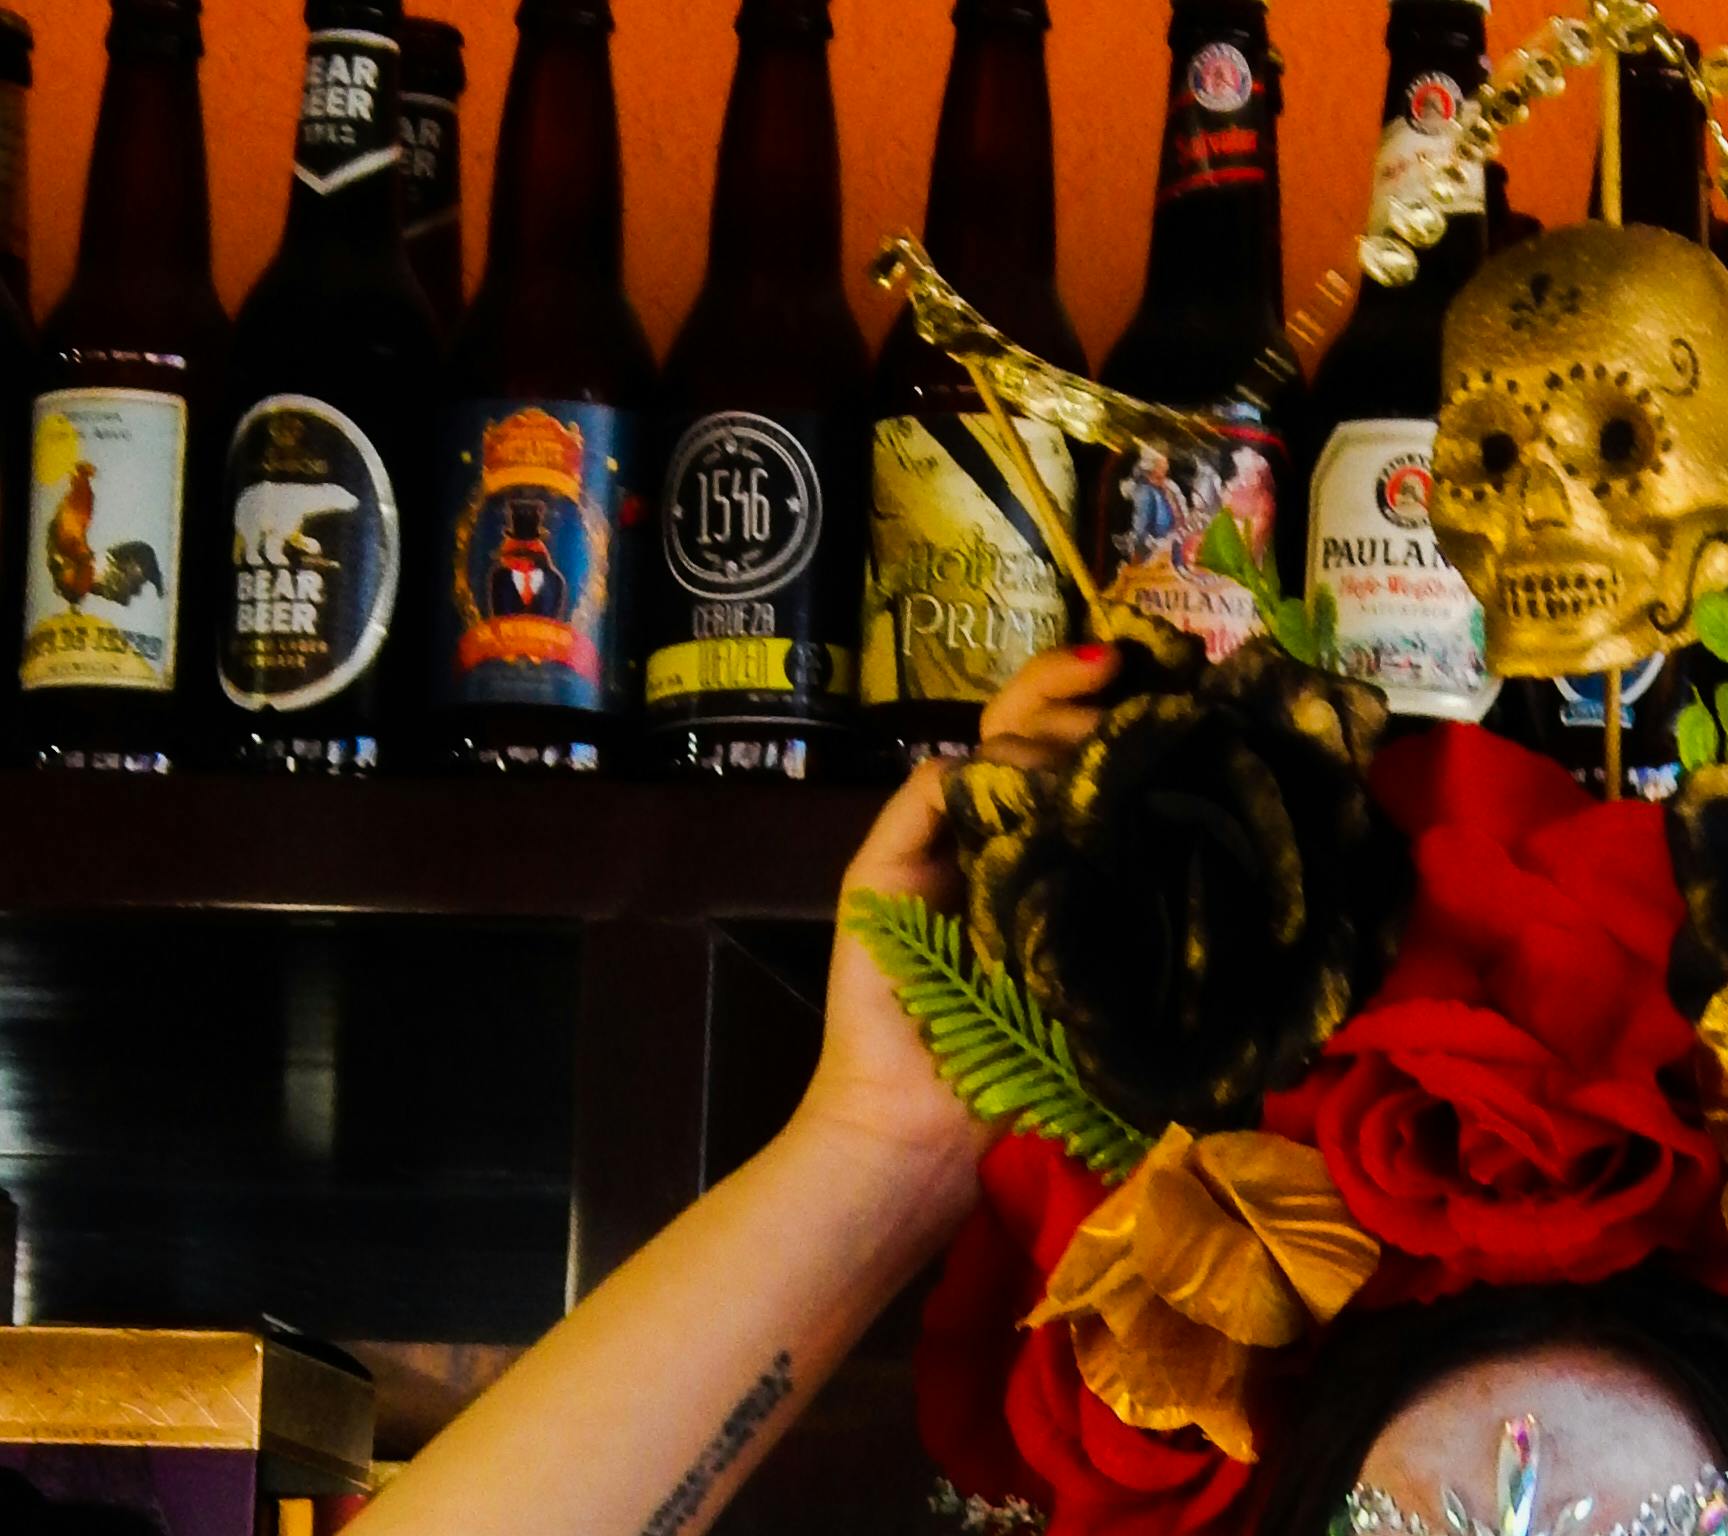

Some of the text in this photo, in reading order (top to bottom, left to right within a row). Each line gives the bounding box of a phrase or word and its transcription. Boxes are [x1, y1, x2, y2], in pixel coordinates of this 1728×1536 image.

[697, 468, 771, 543] 1546
[236, 569, 324, 603] BEAR
[236, 602, 318, 635] BEER
[693, 603, 776, 638] CERVEZA
